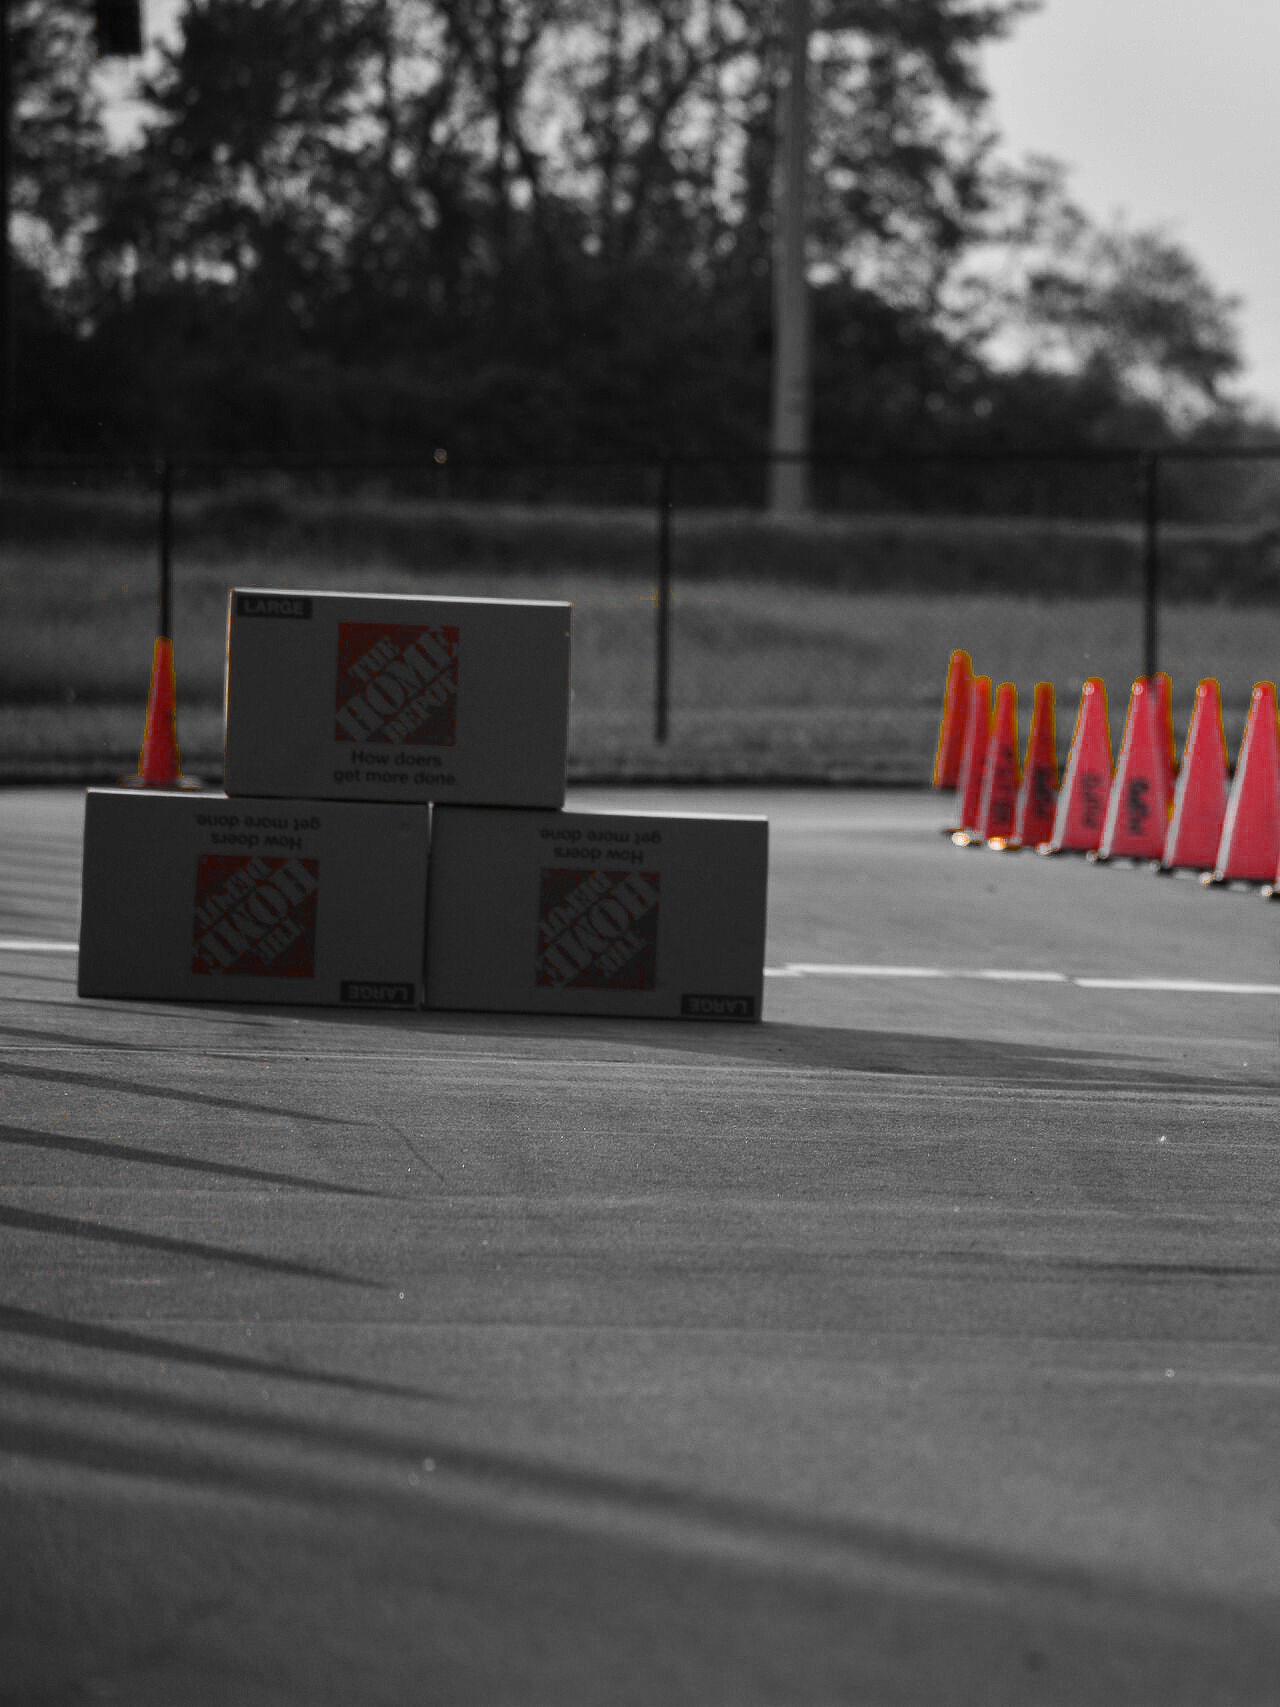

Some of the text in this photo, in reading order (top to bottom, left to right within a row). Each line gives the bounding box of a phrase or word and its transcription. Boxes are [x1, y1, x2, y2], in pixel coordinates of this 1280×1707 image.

[244, 599, 305, 616] LARGE
[335, 624, 459, 746] HOME
[350, 749, 443, 767] How doers
[333, 769, 361, 784] get
[365, 769, 409, 782] more
[245, 816, 288, 829] more
[293, 816, 321, 831] get
[210, 832, 302, 850] How doers
[587, 829, 629, 843] more
[634, 830, 662, 844] get
[552, 846, 643, 864] How doers
[192, 856, 320, 976] HOME
[536, 870, 659, 985] HOME
[348, 985, 408, 1001] LARGE
